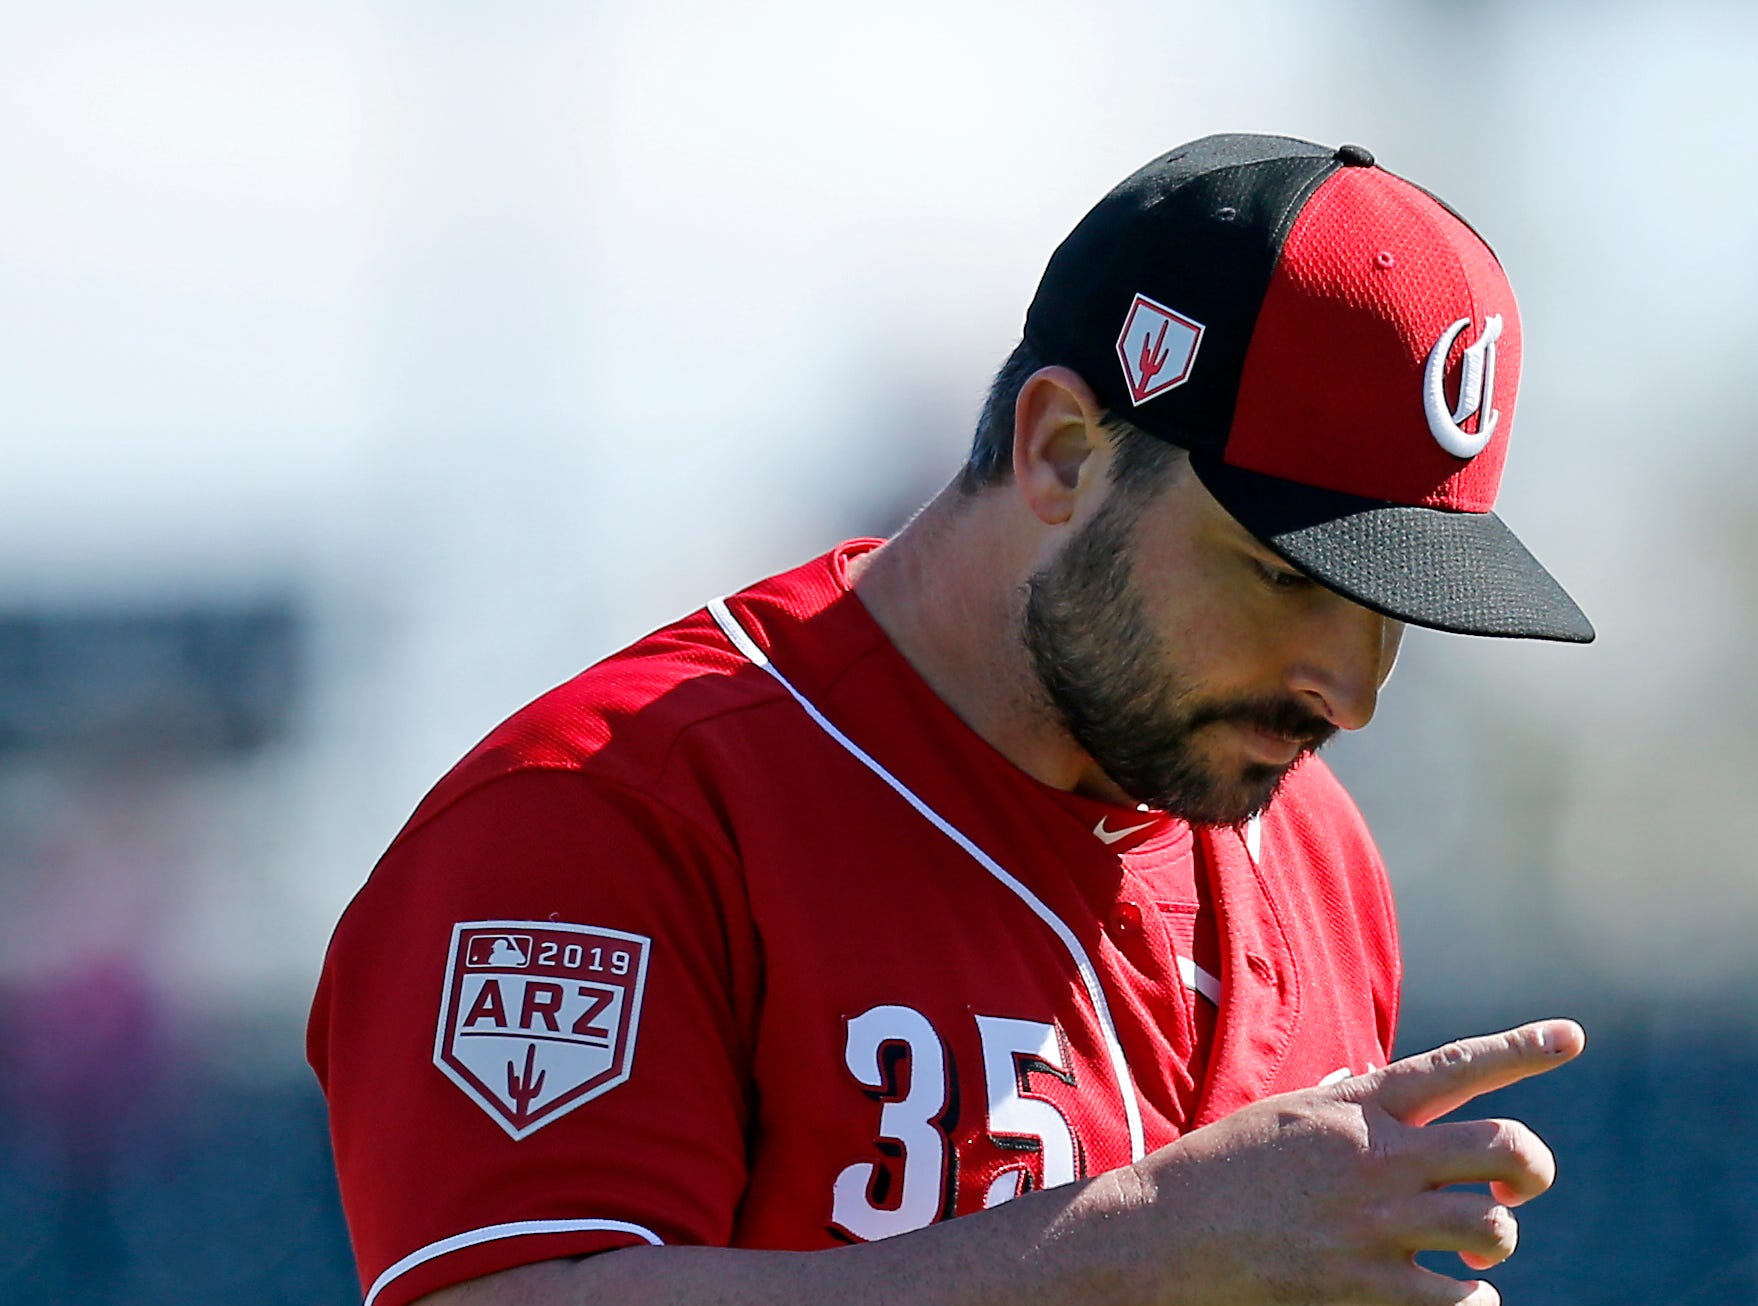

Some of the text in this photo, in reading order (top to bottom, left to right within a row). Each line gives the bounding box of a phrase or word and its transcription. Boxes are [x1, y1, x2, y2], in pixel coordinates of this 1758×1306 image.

[537, 942, 631, 976] 2019
[462, 979, 615, 1038] ARZ
[829, 1004, 1080, 1243] 35
